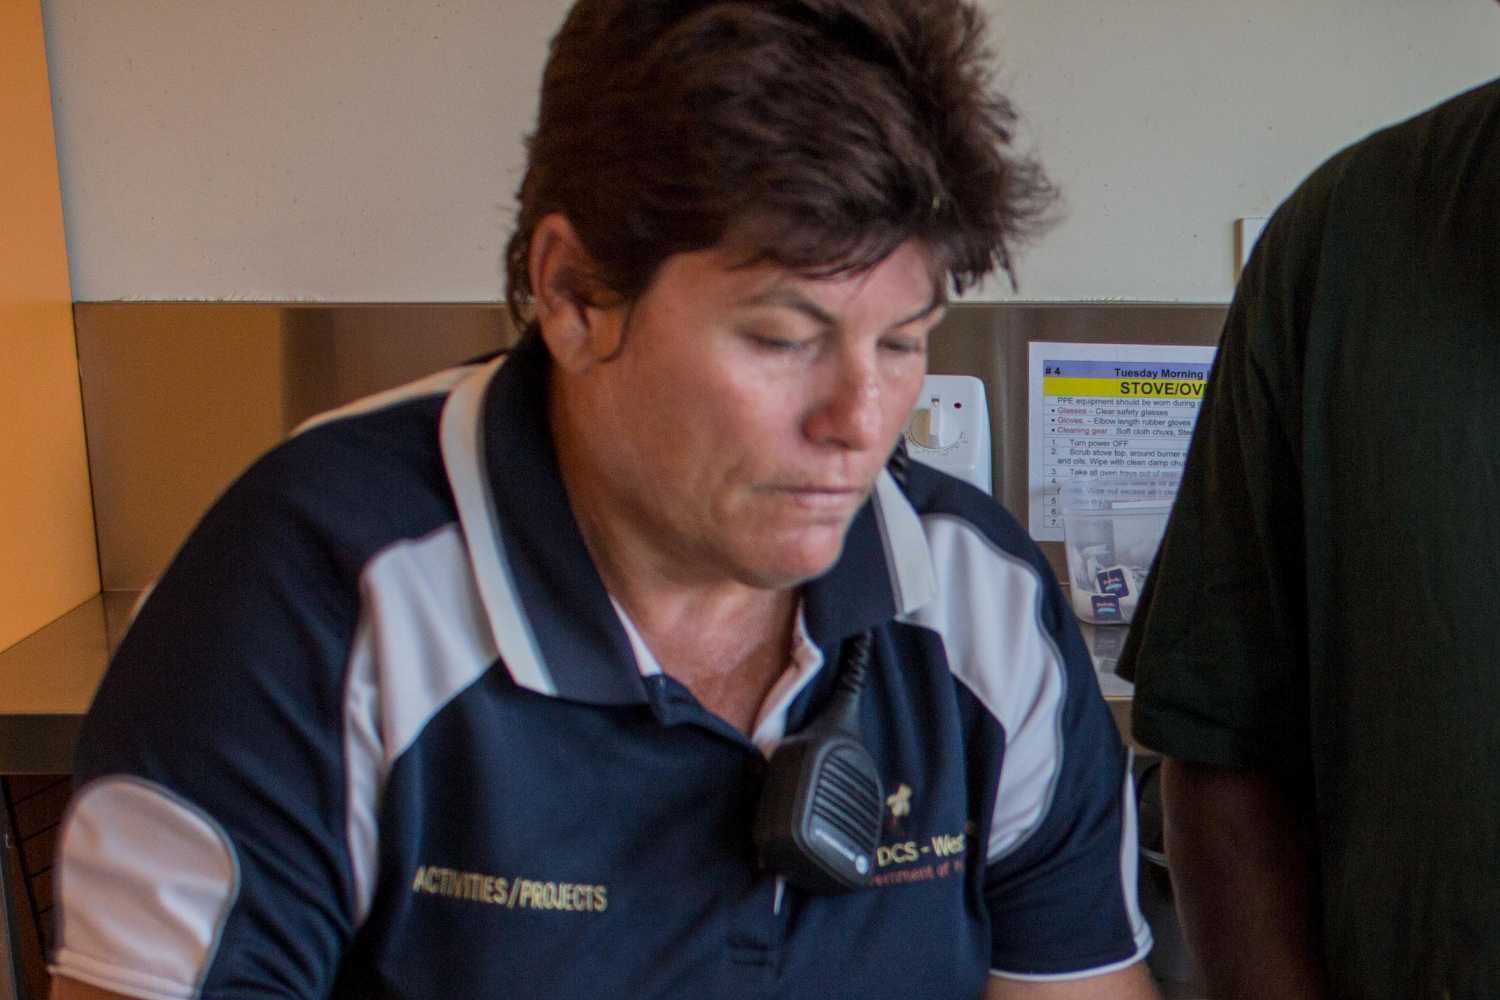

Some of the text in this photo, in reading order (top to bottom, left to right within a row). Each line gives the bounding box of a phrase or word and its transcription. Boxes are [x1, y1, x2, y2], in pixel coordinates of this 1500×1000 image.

[1114, 368, 1158, 379] Tuesday
[1161, 369, 1203, 380] Morning
[876, 841, 919, 867] DCS
[413, 865, 608, 912] ACTIVITIES/PROJECTS
